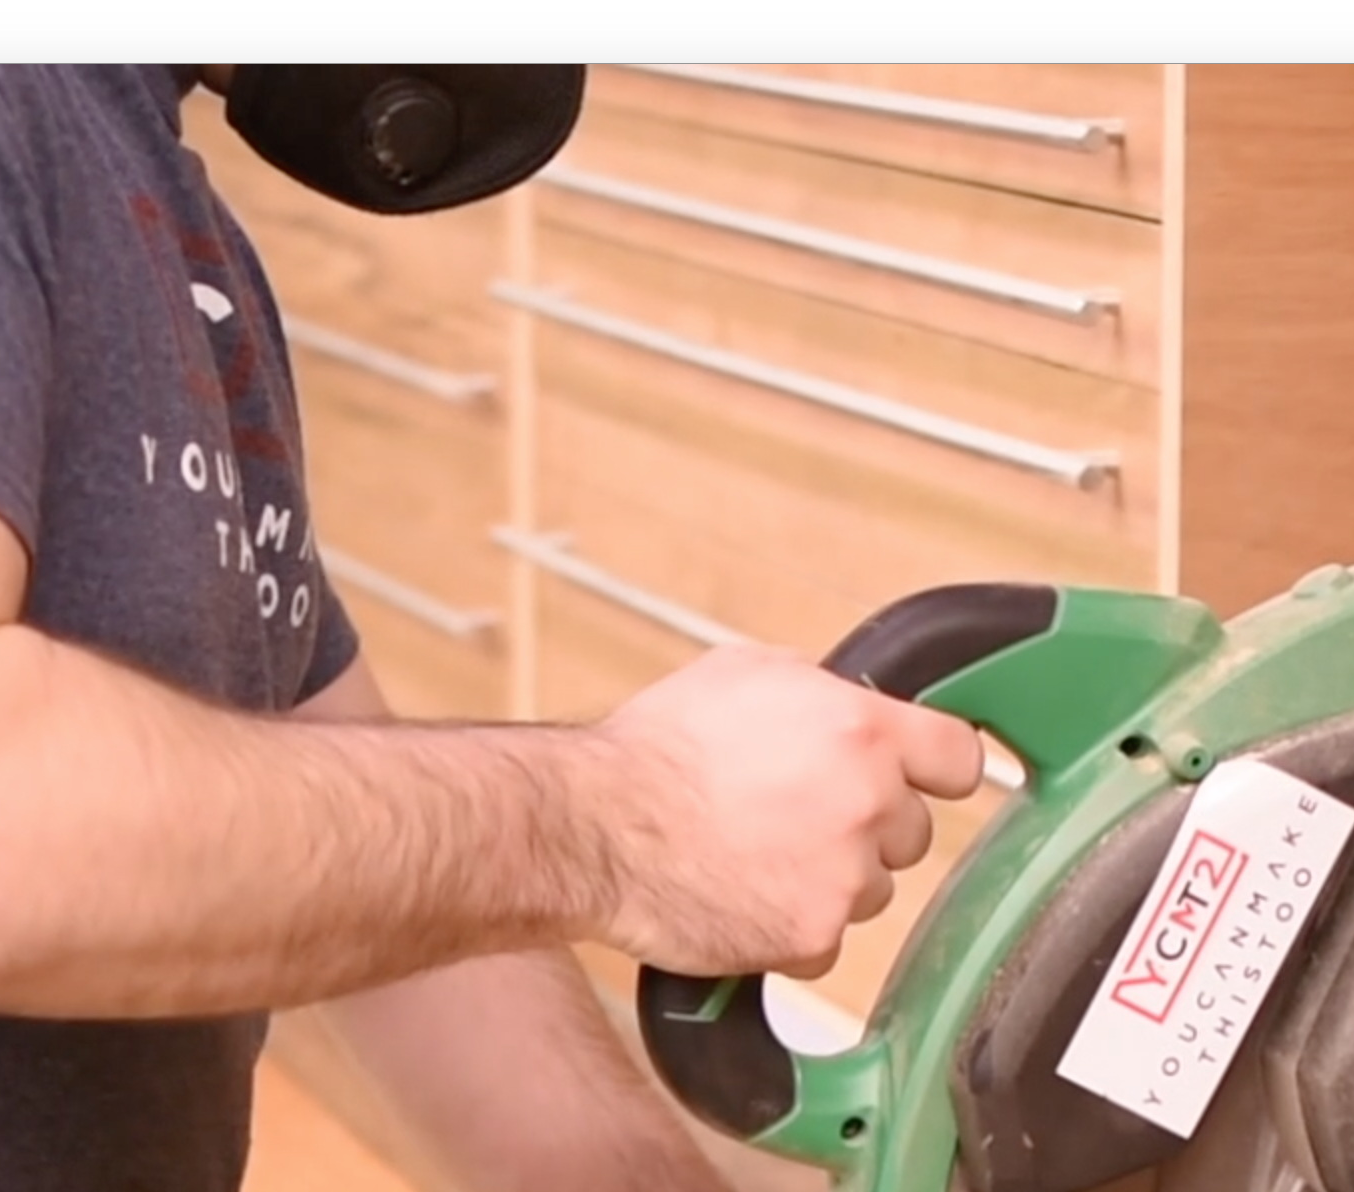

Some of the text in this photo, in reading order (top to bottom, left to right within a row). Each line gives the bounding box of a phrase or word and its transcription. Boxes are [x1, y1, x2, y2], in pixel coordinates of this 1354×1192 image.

[1115, 856, 1223, 990] YCMT2
[1143, 795, 1318, 1106] YOUCANMAKE
[1198, 867, 1312, 1064] THISTOO
